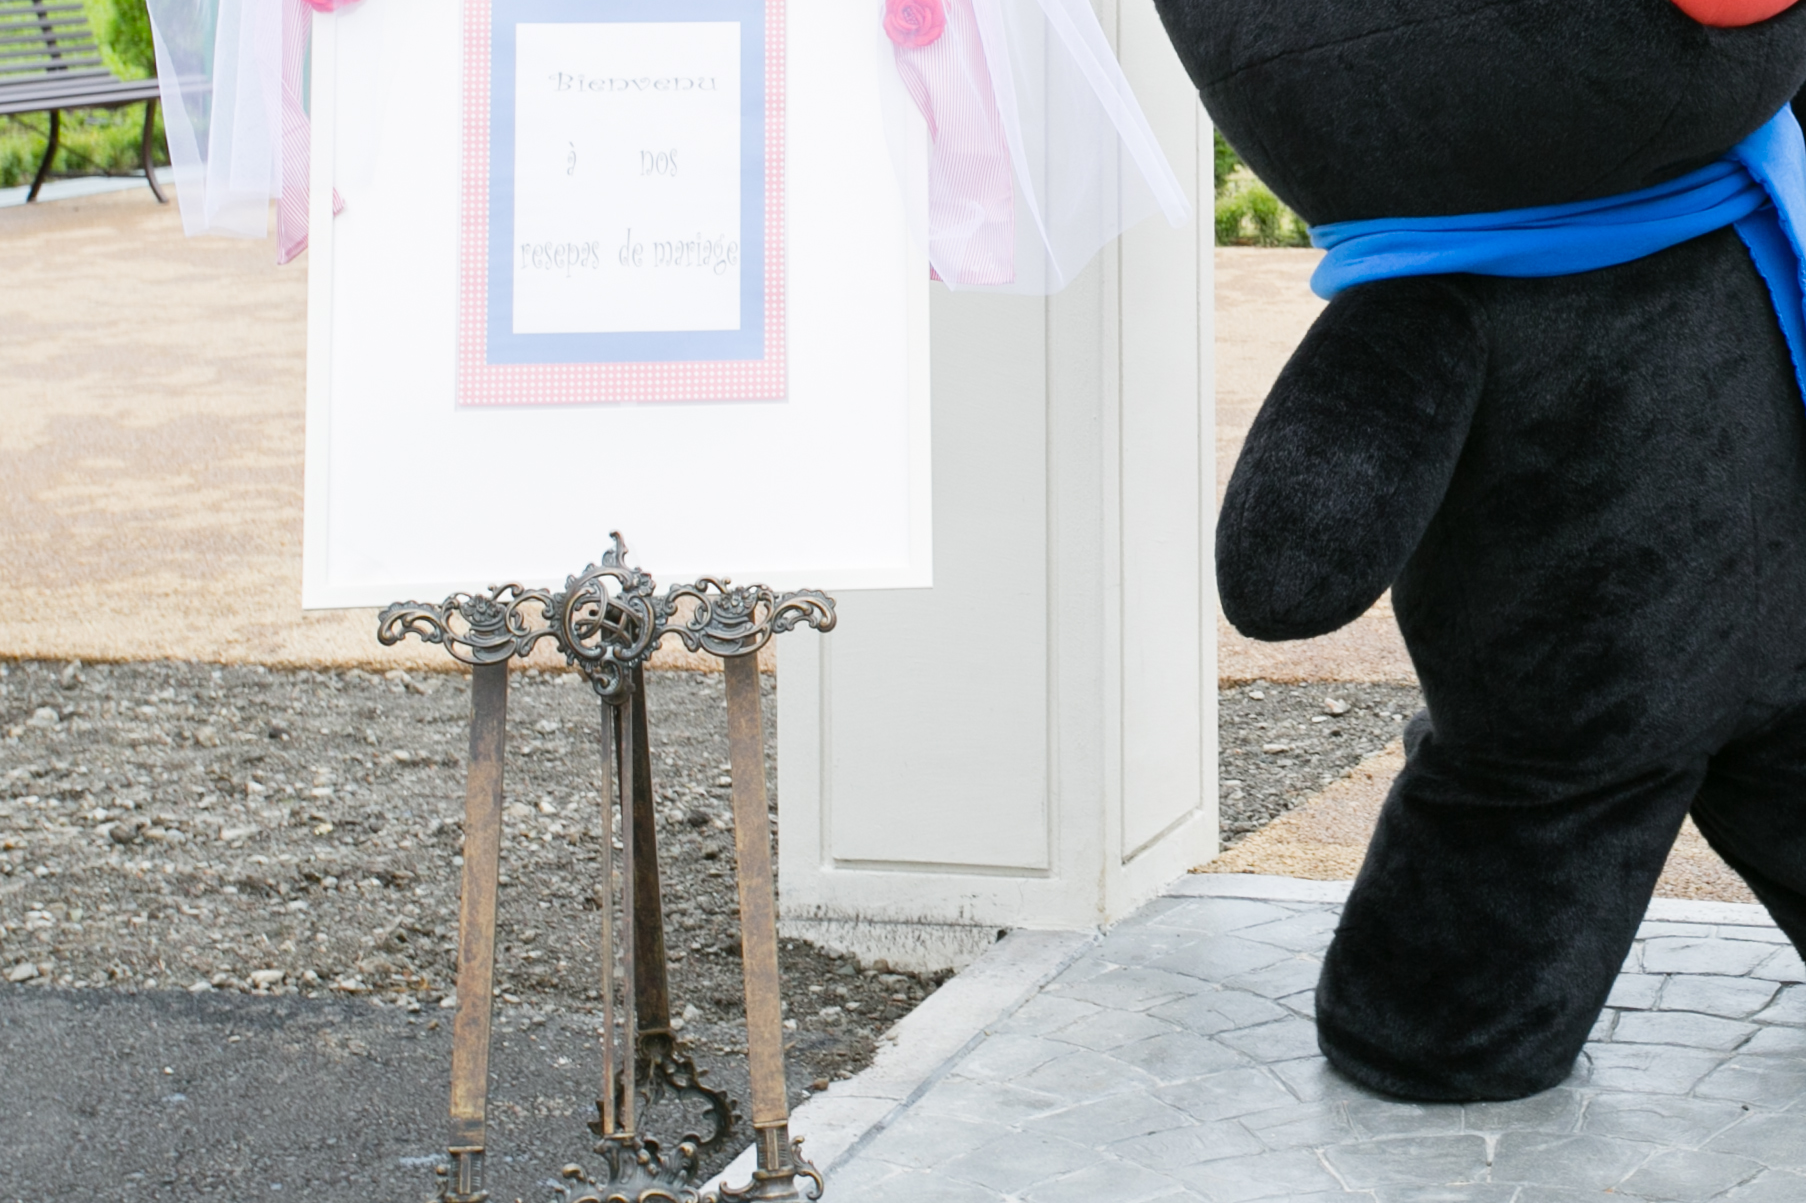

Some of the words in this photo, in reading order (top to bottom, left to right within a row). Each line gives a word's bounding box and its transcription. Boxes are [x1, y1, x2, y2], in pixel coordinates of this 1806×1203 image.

[547, 71, 719, 93] Bienvenu
[566, 141, 577, 176] à
[640, 148, 678, 177] nos
[519, 240, 601, 278] resepas
[618, 227, 645, 268] de
[653, 231, 739, 276] mariage
